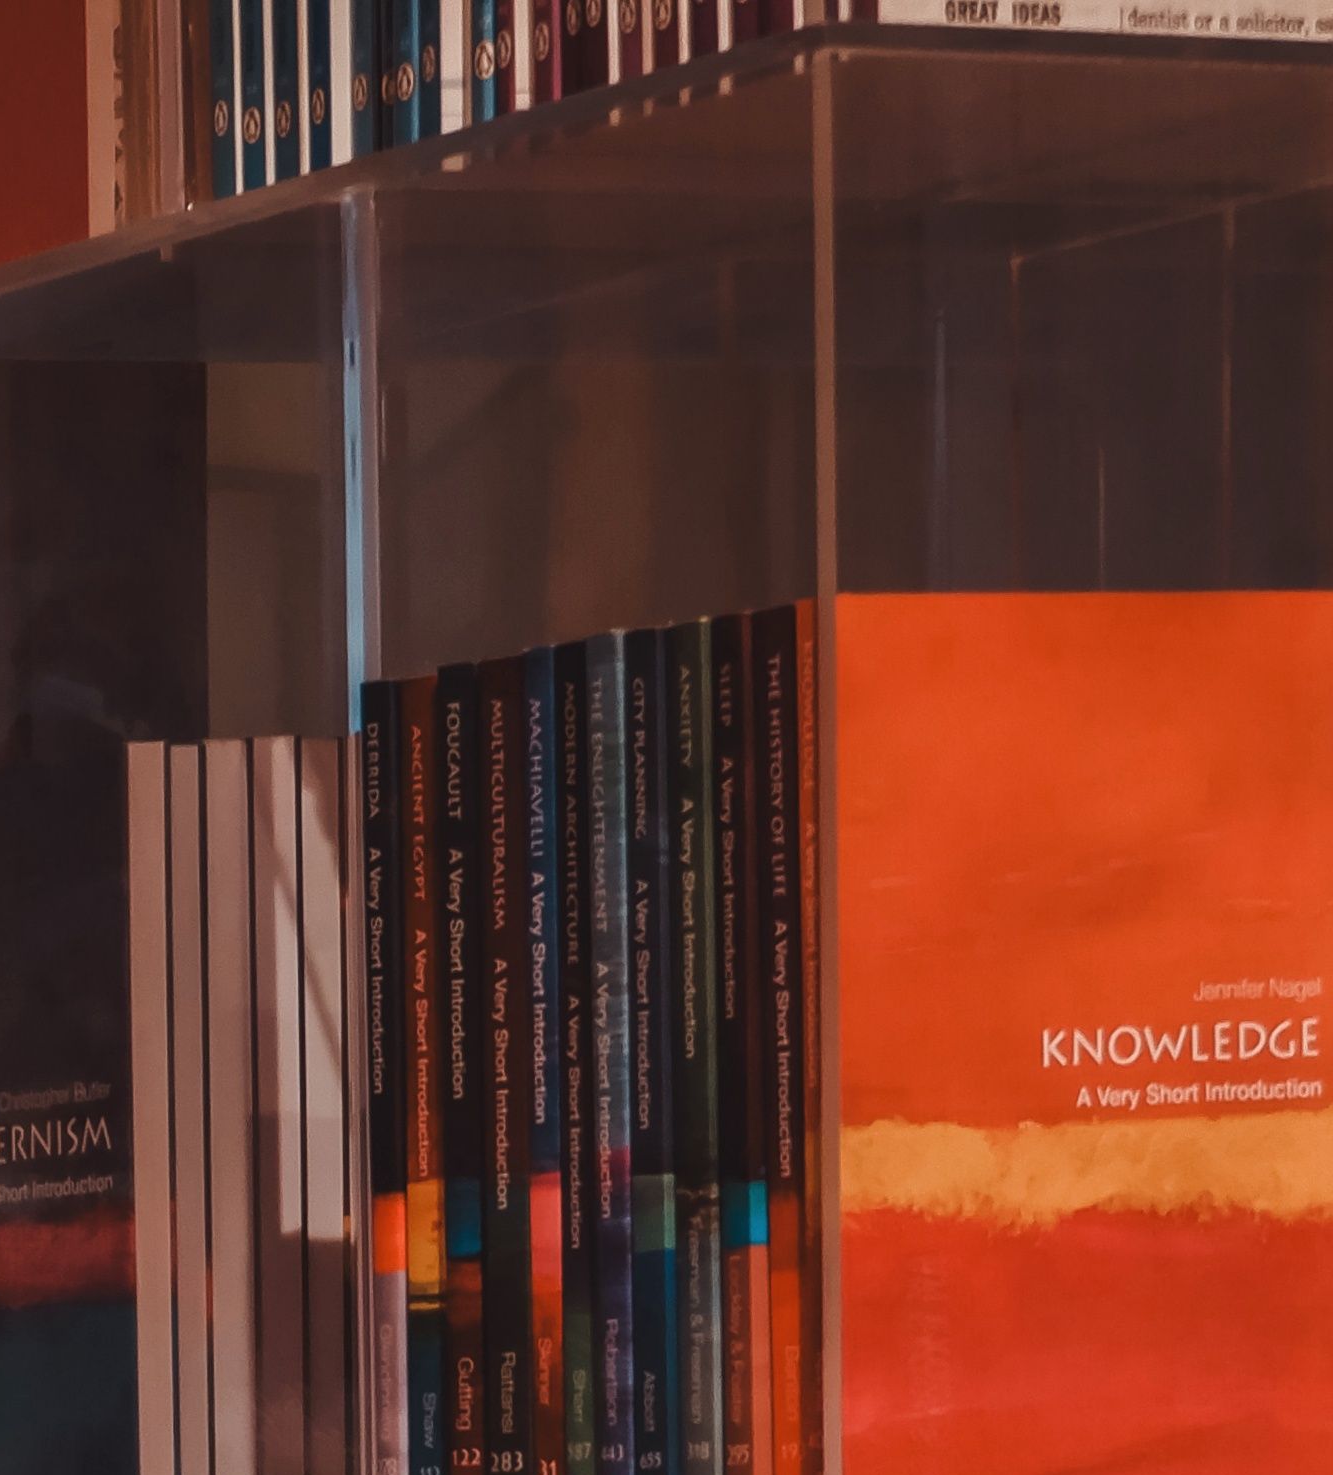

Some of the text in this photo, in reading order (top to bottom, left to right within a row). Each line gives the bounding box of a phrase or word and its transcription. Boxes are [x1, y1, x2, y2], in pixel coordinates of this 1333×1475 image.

[944, 0, 1061, 26] GREAT IDEAS
[1128, 10, 1189, 29] dentist
[1194, 15, 1214, 30] or
[1219, 19, 1229, 30] a
[367, 722, 386, 1093] DERRIDA A Very Short Introduction
[1194, 977, 1321, 1002] Jennifer Nagel
[529, 699, 554, 1406] MACHIAVELLI A Very Short Introduction Skinner
[1042, 1016, 1319, 1068] KNOWLEDGE
[447, 702, 473, 1431] FOUCAULT A Very Short Introduction Gutting
[490, 700, 516, 1434] MULTICULTURALISM Rattansi
[1077, 1079, 1322, 1110] A Very Short Introduction
[32, 1174, 114, 1198] Introduction
[453, 1449, 481, 1465] 122
[491, 1452, 523, 1472] 283
